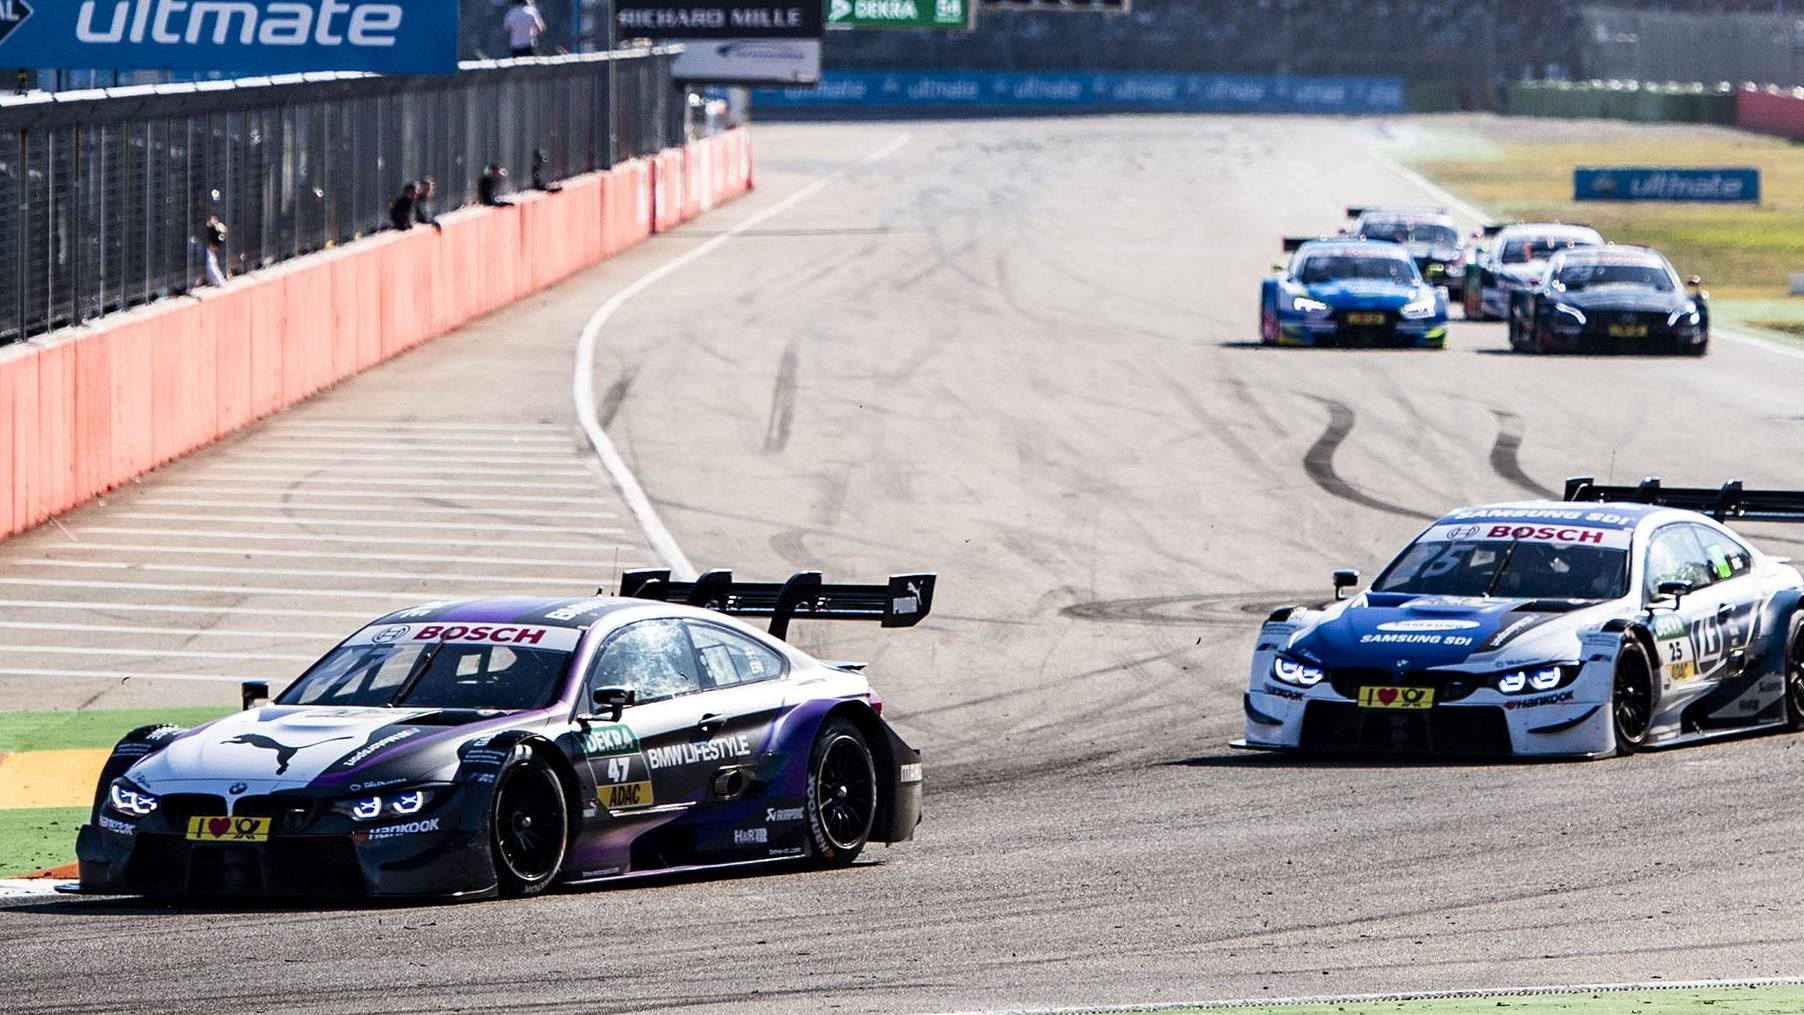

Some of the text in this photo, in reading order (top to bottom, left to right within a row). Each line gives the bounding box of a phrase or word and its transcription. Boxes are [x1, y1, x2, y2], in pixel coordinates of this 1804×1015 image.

[617, 8, 801, 28] RICHARD MILLE
[854, 0, 919, 20] DEKRA
[1454, 508, 1634, 525] SAMSUNG SDI
[1487, 525, 1604, 544] BOSCH
[412, 625, 548, 645] BOSCH
[1360, 633, 1473, 647] SAMSUNG SDI
[1669, 641, 1683, 662] 25
[586, 728, 634, 753] DEKRA
[647, 735, 751, 769] BMW LIFESTYLE
[607, 757, 630, 782] 47
[609, 784, 641, 807] ADAC
